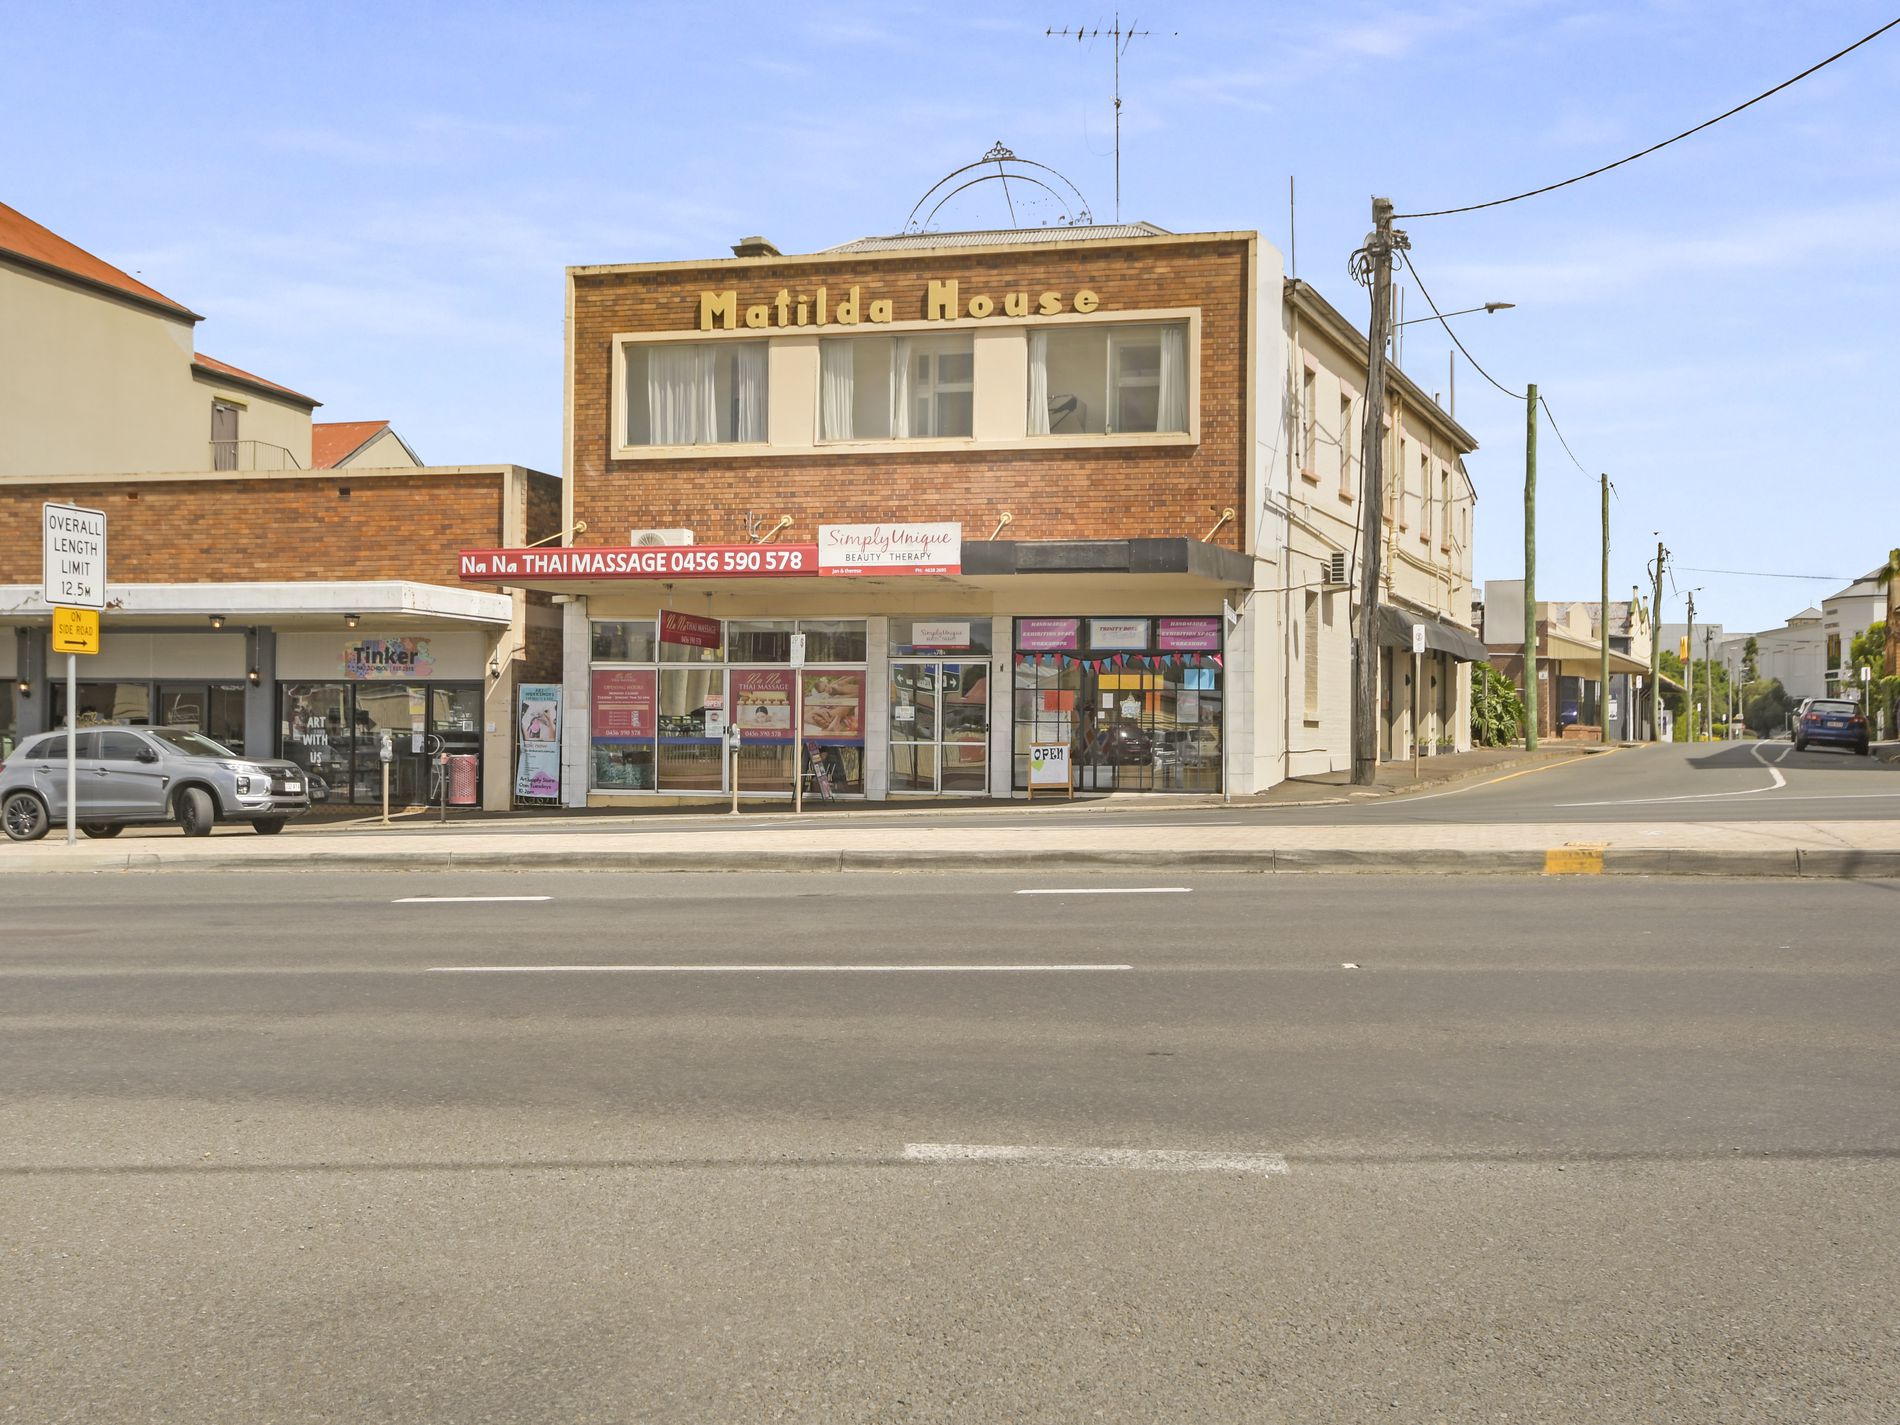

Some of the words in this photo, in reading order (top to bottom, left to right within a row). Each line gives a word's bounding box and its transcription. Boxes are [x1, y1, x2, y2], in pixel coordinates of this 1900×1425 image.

[700, 285, 892, 330] Matilda
[927, 279, 1099, 320] House
[49, 515, 101, 536] OVERALL
[54, 537, 98, 556] LENGTH
[462, 556, 486, 573] Na
[492, 555, 517, 573] Na
[522, 555, 567, 573] THAI
[571, 553, 667, 573] MASSAGE
[671, 552, 719, 571] 0456
[724, 552, 760, 571] 590
[765, 551, 803, 570] 578
[846, 554, 881, 562] BEAUTY
[890, 552, 932, 561] THERAPY
[61, 560, 90, 576] LIMIT
[71, 614, 81, 622] ON
[59, 624, 73, 635] SIDE
[76, 626, 93, 636] ROAD
[354, 646, 418, 664] Tinker
[307, 717, 326, 728] ART
[303, 734, 328, 745] WITH
[310, 752, 322, 764] US
[1034, 747, 1064, 760] OPEN
